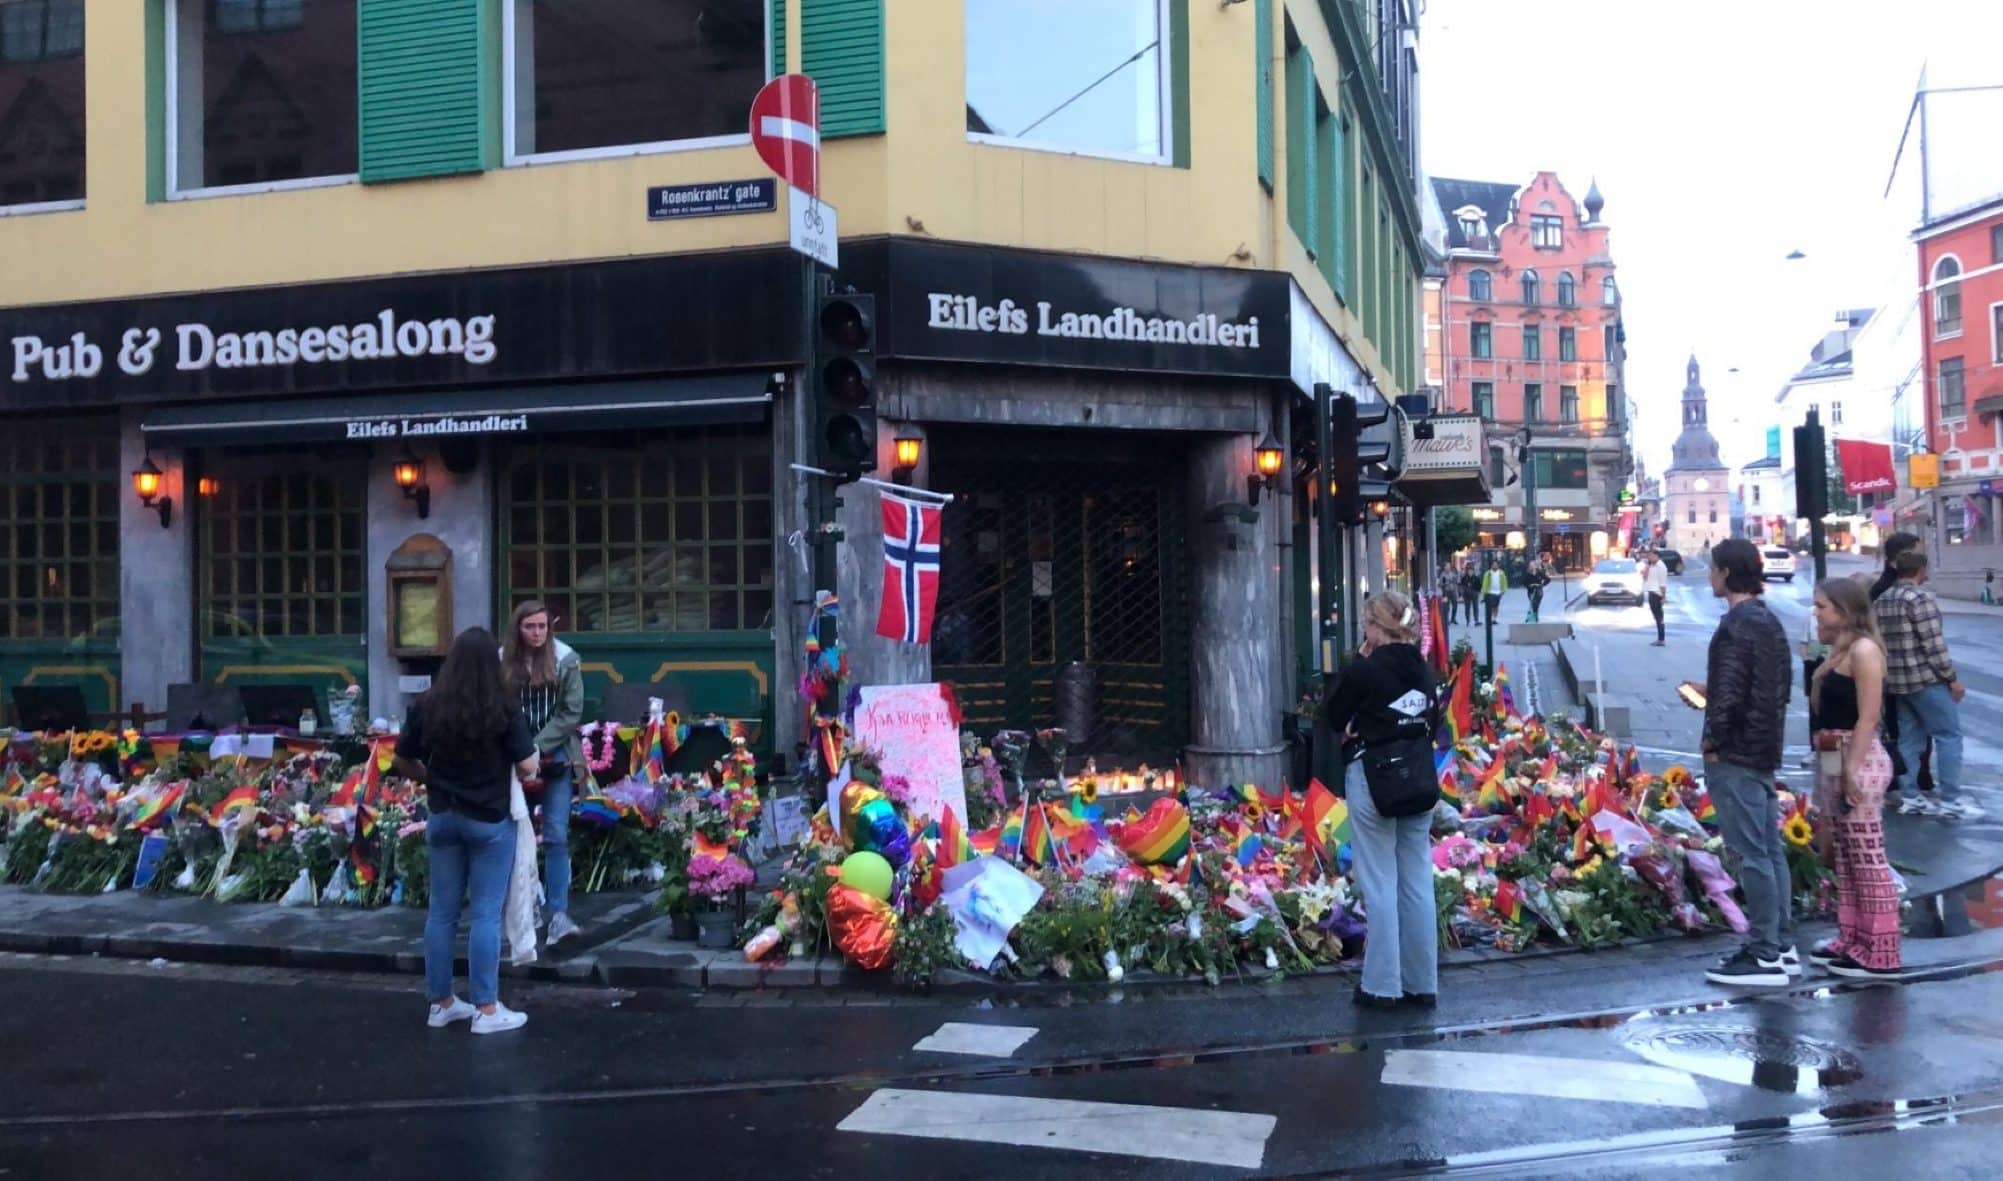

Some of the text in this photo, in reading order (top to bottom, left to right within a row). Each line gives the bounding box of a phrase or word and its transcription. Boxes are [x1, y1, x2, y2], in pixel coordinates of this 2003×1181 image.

[735, 183, 761, 203] gate
[927, 292, 1261, 349] Eilefs Landhandleri
[11, 308, 497, 382] Pub & Dansesalong
[346, 414, 528, 438] Eilefs Landhandleri
